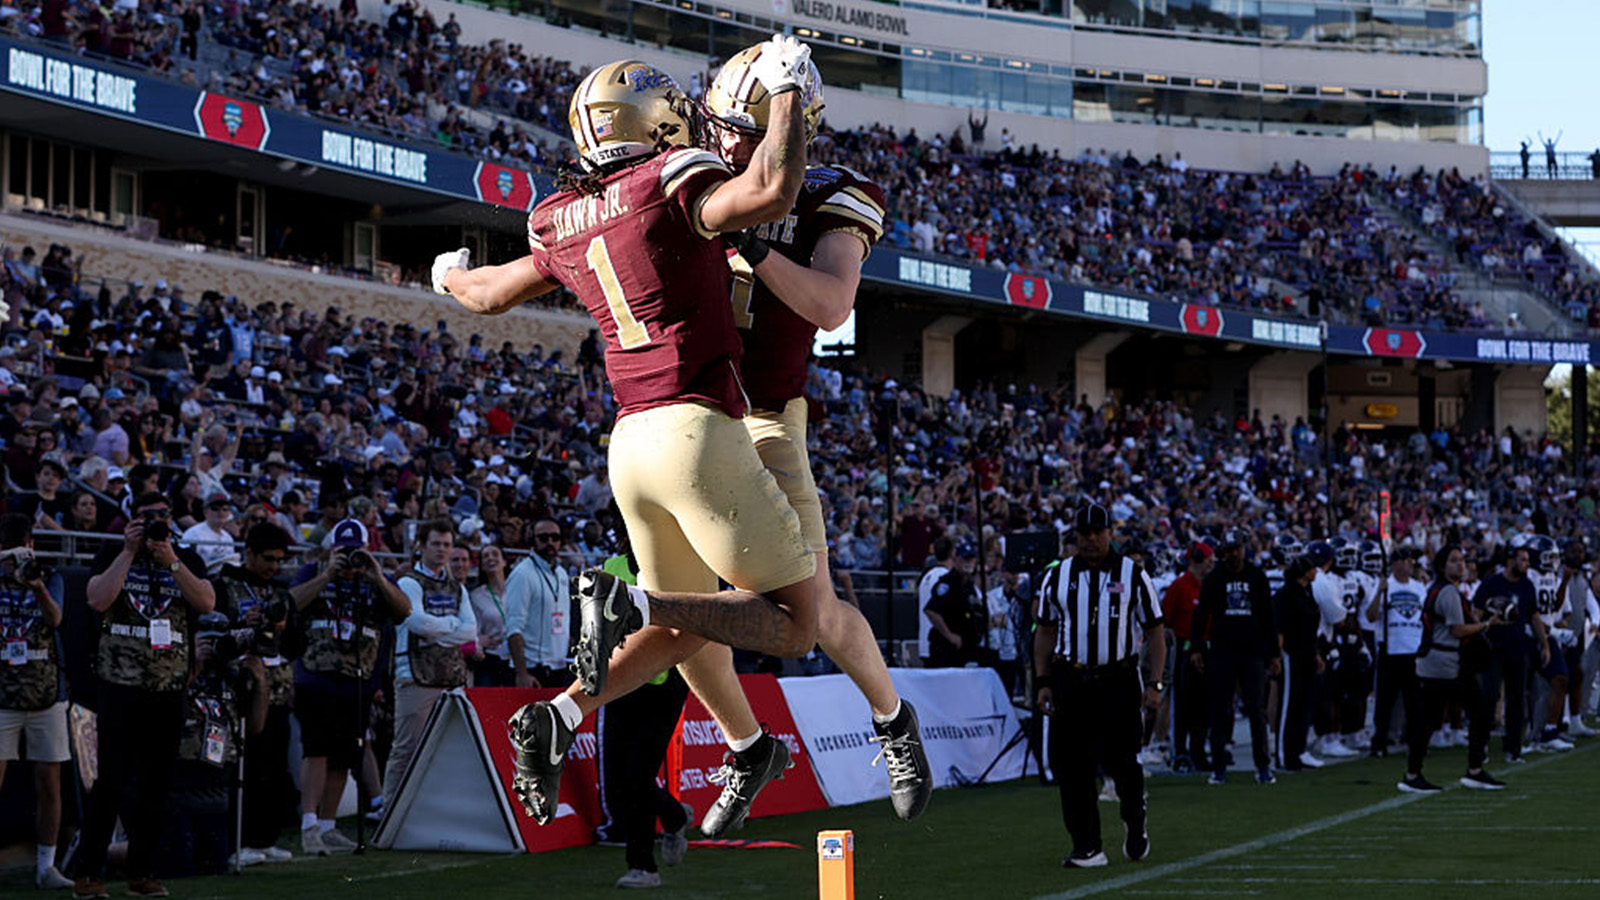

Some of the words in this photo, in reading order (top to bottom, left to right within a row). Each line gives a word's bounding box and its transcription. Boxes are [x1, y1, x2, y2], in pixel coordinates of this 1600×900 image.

[791, 0, 834, 21] VALERO
[835, 5, 874, 29] ALAMO
[876, 13, 909, 36] BOWL
[9, 47, 45, 91] BOWL
[45, 57, 71, 97] FOR
[72, 64, 96, 104] THE
[96, 71, 137, 113] BRAVE
[322, 129, 353, 166] BOWL
[353, 137, 374, 171] FOR
[375, 142, 394, 176] THE
[598, 146, 630, 160] STATE
[553, 193, 598, 240] DAWN
[600, 182, 629, 224] JR.
[586, 235, 651, 350] 1
[1477, 338, 1507, 359] BOWL
[1508, 340, 1530, 360] FOR
[1531, 341, 1551, 361] THE
[1552, 342, 1590, 361] BRAVE
[814, 732, 863, 752] LOCKHEED
[920, 725, 963, 740] LOCKHEED
